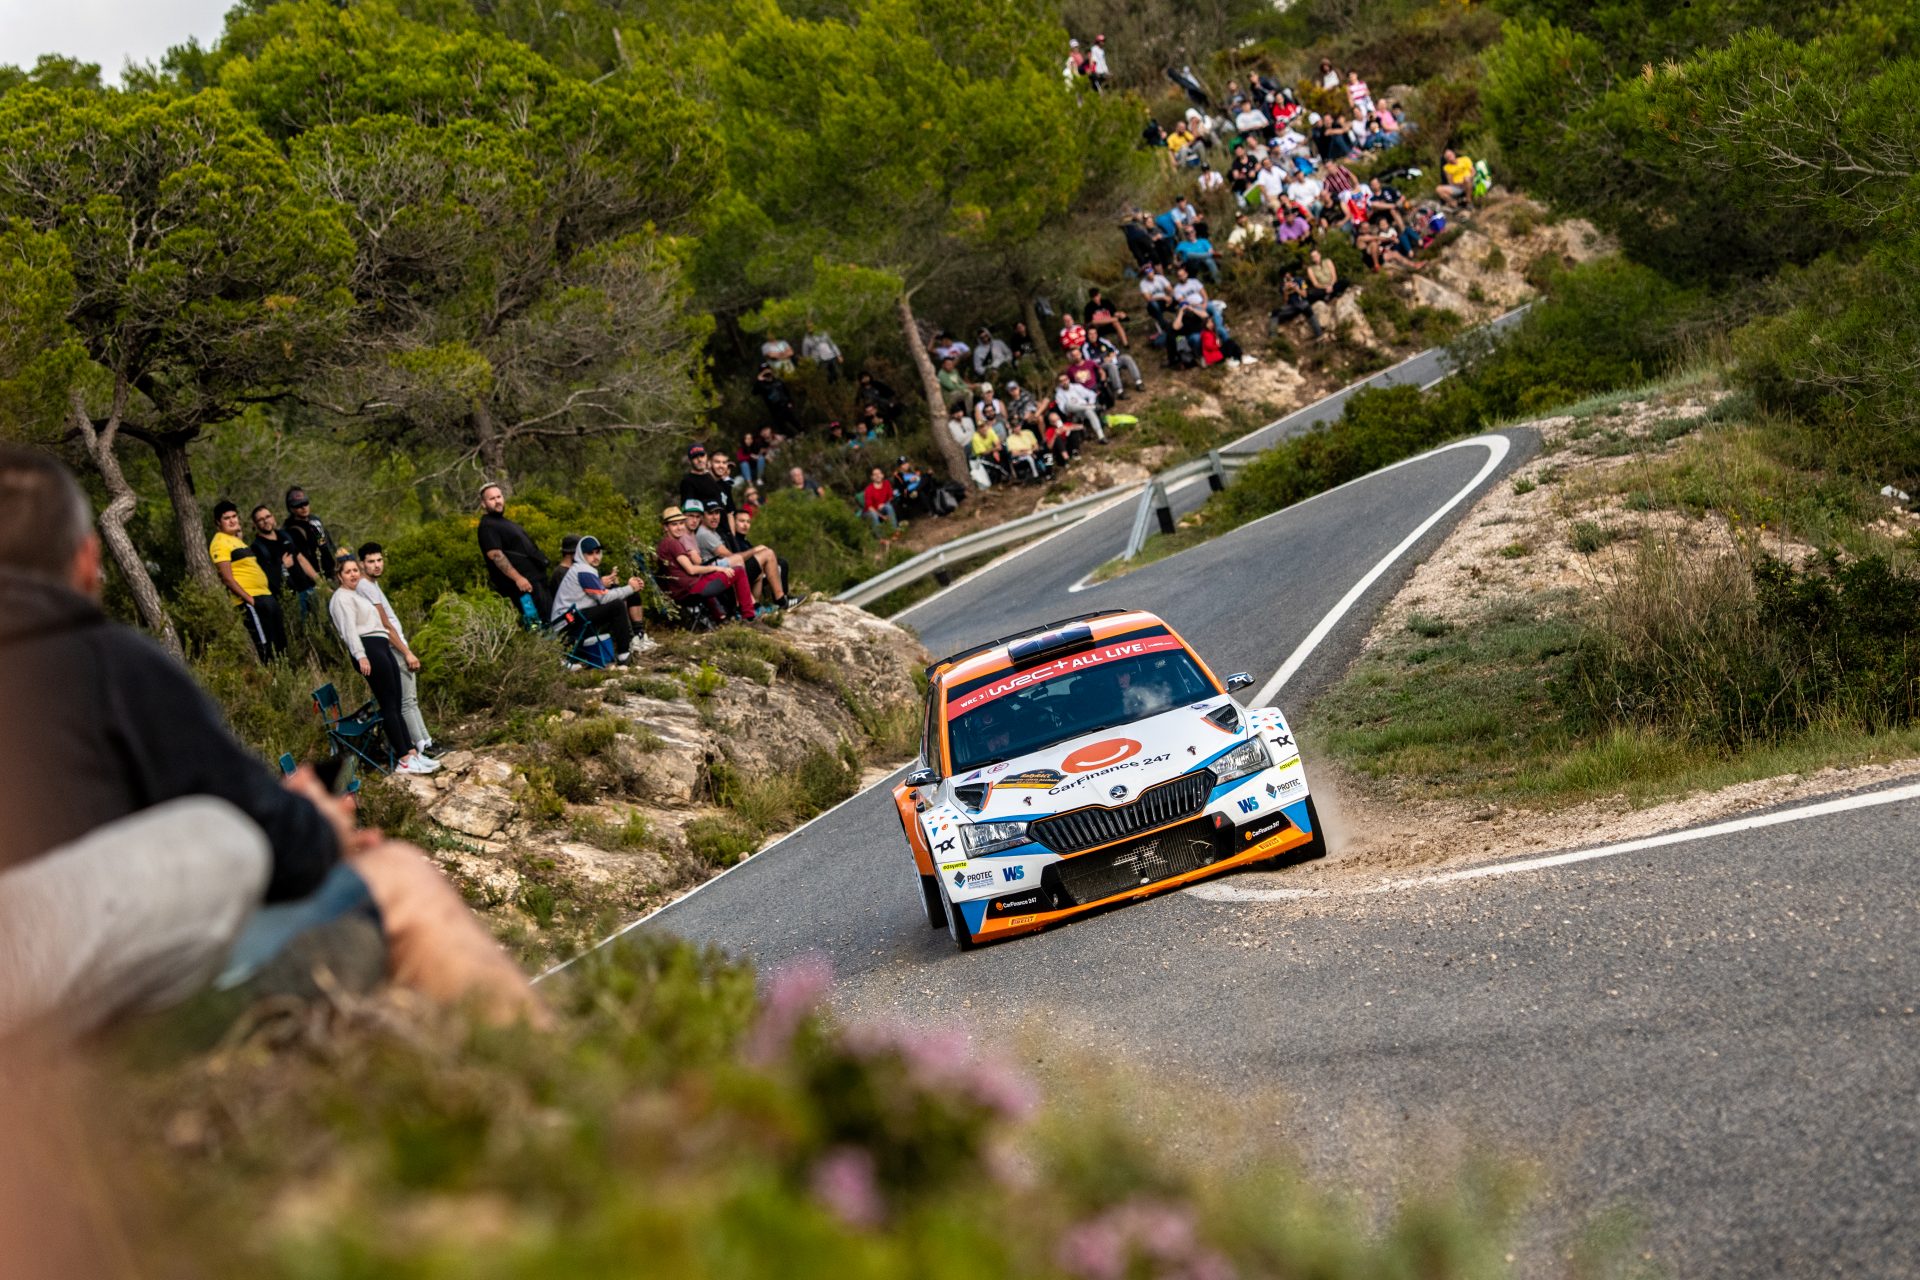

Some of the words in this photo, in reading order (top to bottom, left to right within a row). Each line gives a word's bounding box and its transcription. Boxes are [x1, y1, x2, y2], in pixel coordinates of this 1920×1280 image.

[1072, 654, 1103, 668] ALL
[1105, 643, 1144, 658] LIVE
[960, 697, 977, 708] WRC
[1048, 761, 1139, 796] CarFinance
[1142, 753, 1171, 766] 247
[1276, 778, 1301, 793] PROTEC
[1237, 796, 1260, 814] WS
[967, 870, 993, 882] PROTEC
[1002, 865, 1025, 882] WS
[1002, 900, 1028, 908] CarFinance
